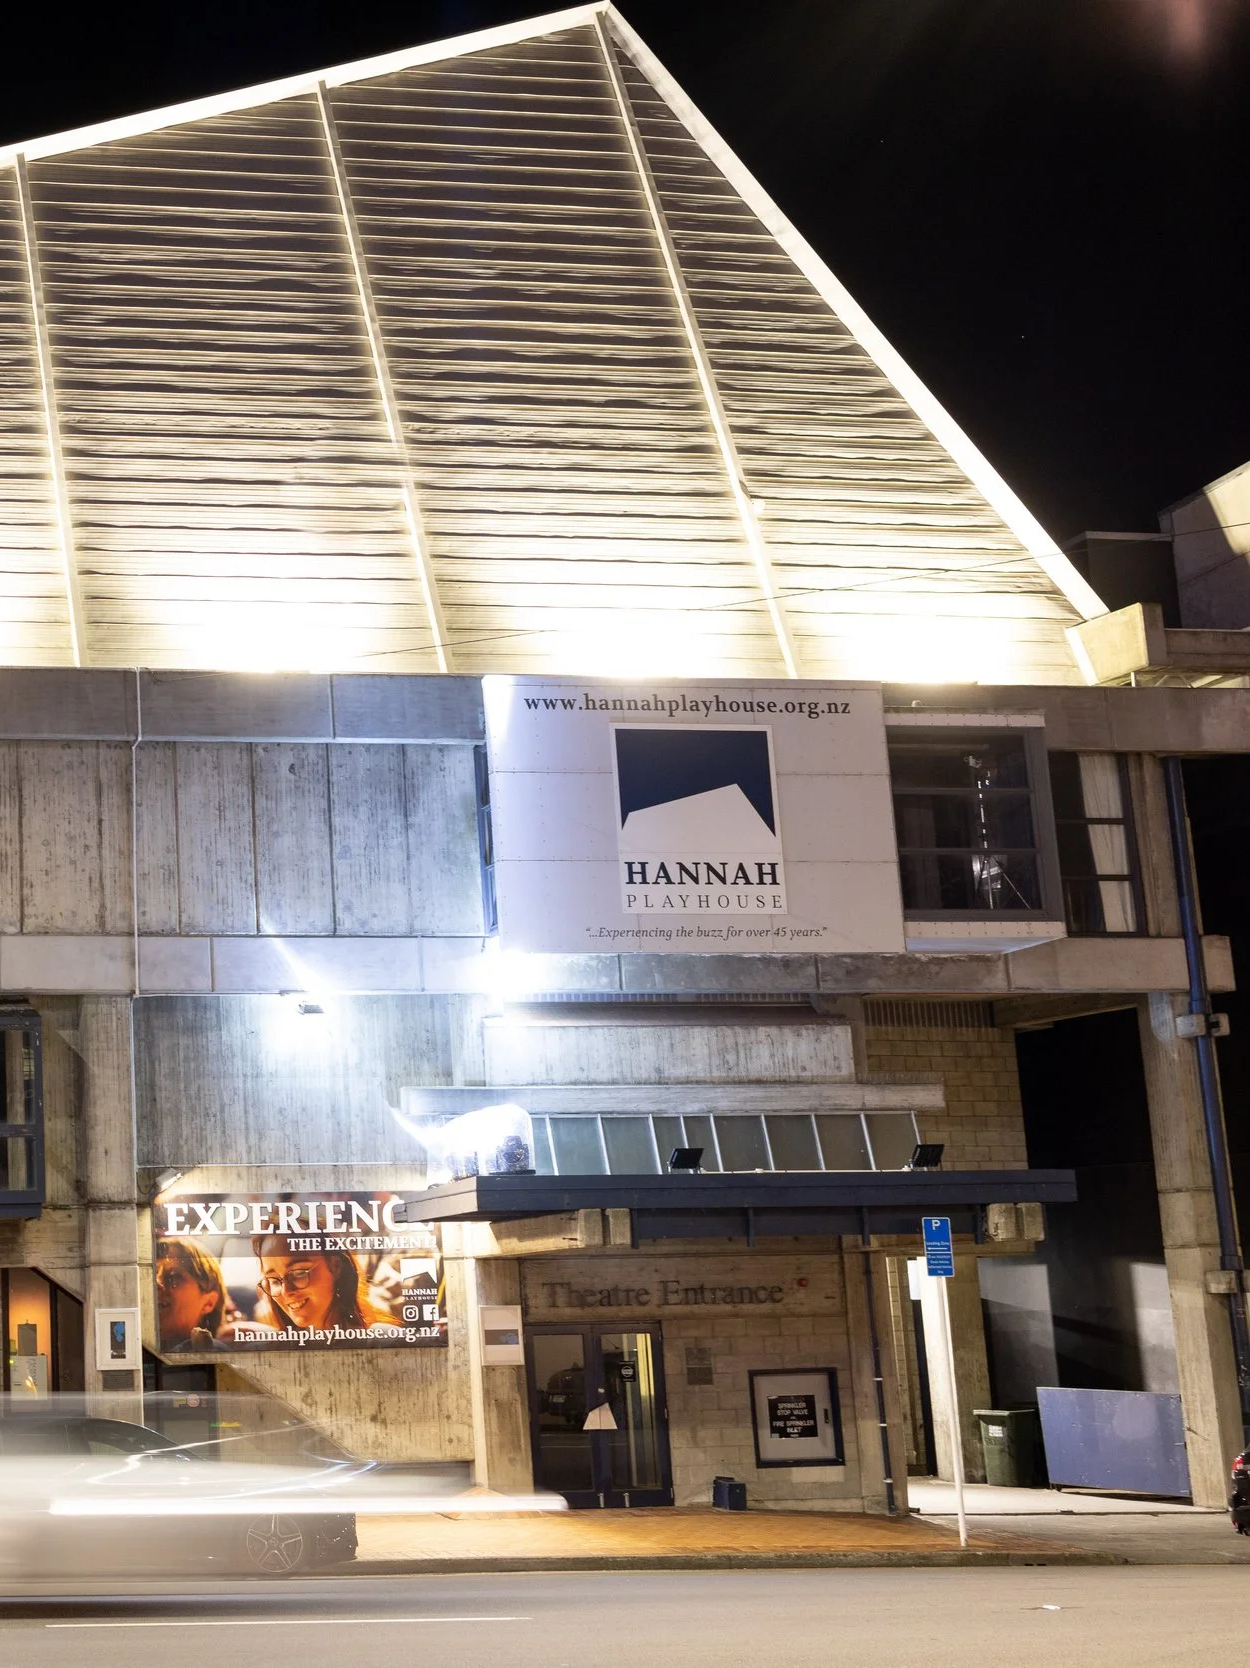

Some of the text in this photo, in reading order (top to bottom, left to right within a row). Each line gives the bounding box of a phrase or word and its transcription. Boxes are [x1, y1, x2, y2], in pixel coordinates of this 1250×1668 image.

[524, 693, 851, 719] www.hannahplayhouse.org.nz
[624, 861, 781, 886] HANNAH
[627, 894, 783, 909] PLAYHOUSE
[676, 926, 693, 937] the
[696, 926, 723, 938] buzz
[723, 926, 743, 940] for
[746, 929, 771, 937] over
[773, 927, 787, 937] 45
[164, 1195, 434, 1236] EXPERIENC
[932, 1219, 940, 1231] P
[287, 1238, 321, 1252] THE
[402, 1288, 437, 1296] HANNAH
[541, 1280, 784, 1308] Theatre Entrance
[234, 1325, 440, 1346] hannahplayhouse.org.nz
